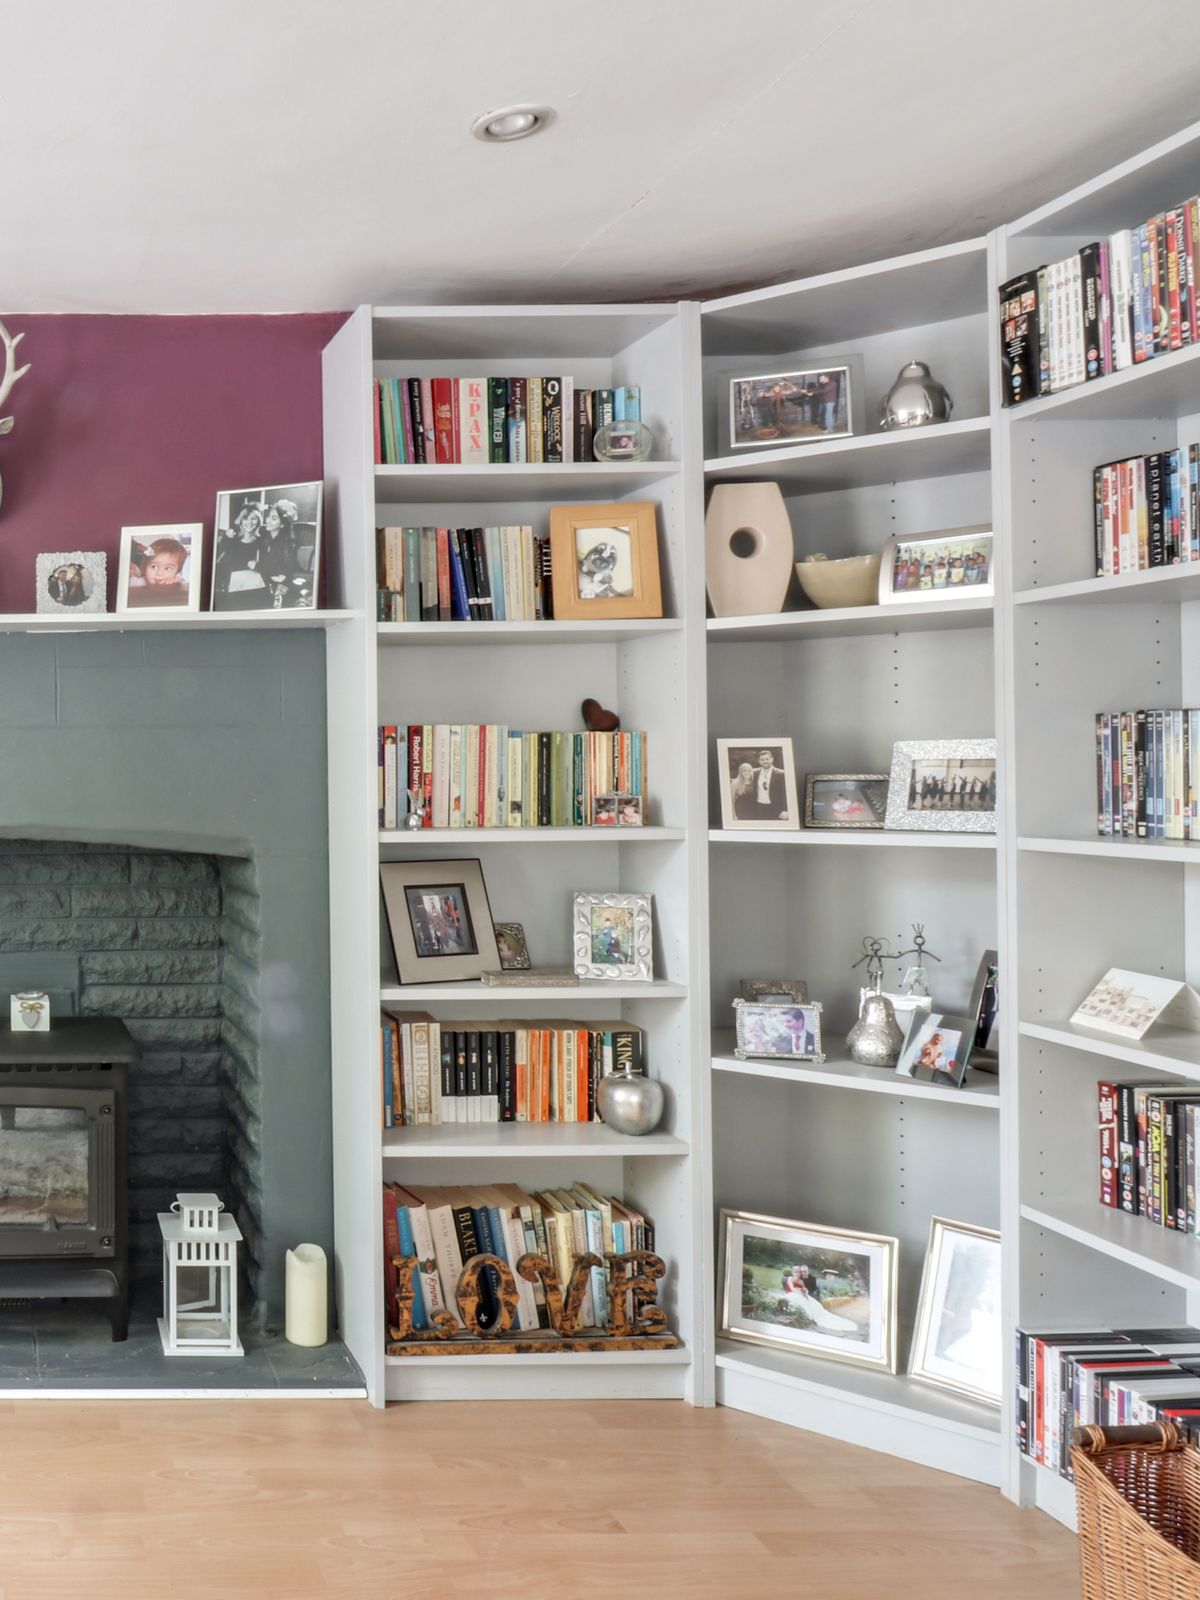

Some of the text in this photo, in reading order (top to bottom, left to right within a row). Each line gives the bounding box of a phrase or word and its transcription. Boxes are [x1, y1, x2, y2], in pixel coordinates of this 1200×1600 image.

[1175, 216, 1187, 284] DONNIE DARKO
[1086, 277, 1096, 320] ROBOCOP
[493, 407, 505, 443] WICKED
[551, 406, 561, 442] WEDLOCK
[1150, 469, 1162, 563] planet earth
[412, 736, 421, 764] Robert
[616, 1037, 632, 1068] KING
[458, 1212, 478, 1256] BLAKE
[389, 1251, 667, 1340] LOVE
[426, 1277, 440, 1307] Emma
